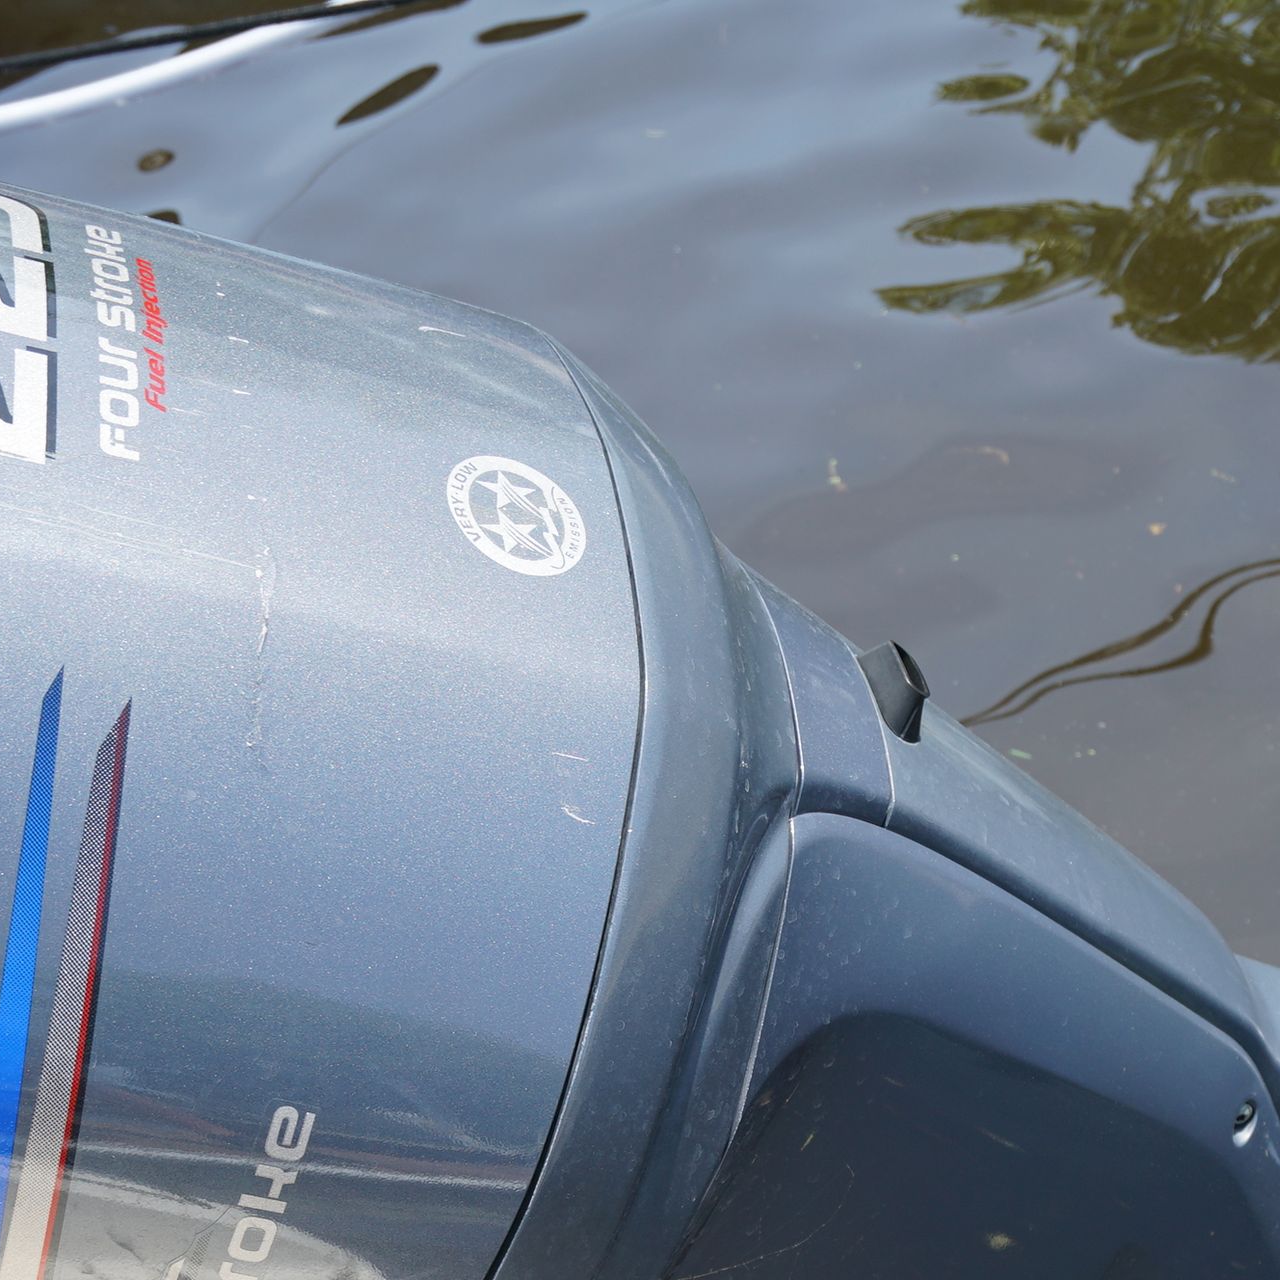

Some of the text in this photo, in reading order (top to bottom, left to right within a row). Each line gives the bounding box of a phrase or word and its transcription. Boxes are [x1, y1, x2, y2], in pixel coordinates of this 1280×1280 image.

[135, 257, 169, 413] Fuel Injection
[555, 497, 581, 560] EMISSION
